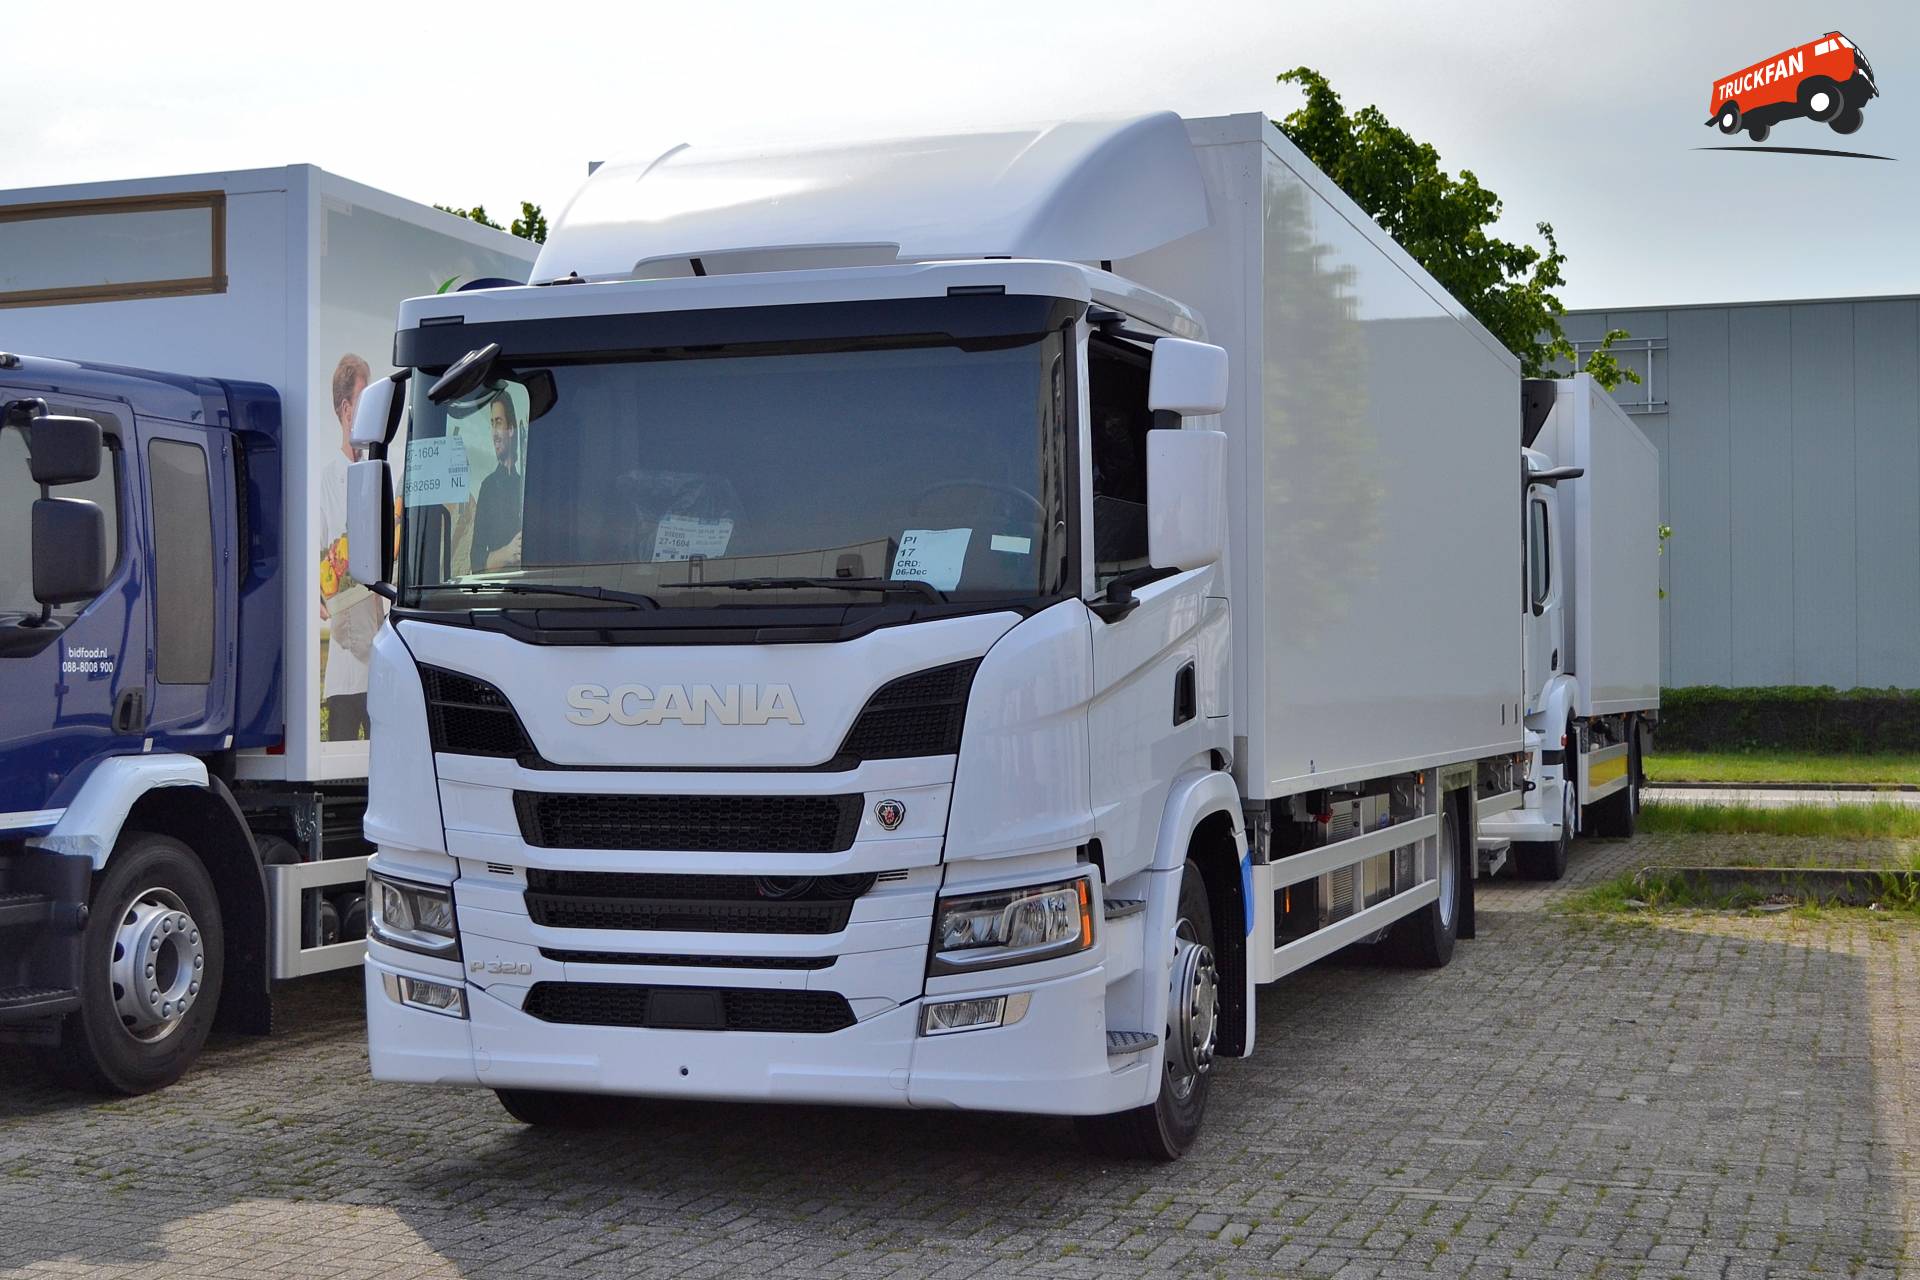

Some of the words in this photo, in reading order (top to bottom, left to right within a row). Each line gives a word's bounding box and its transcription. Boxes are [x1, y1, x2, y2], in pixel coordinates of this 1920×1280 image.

[451, 477, 465, 488] NL
[903, 536, 918, 545] PI
[900, 549, 916, 557] 17
[68, 647, 108, 658] bidfood.nl
[62, 661, 98, 673] 088-8008
[100, 661, 114, 673] 900
[565, 683, 805, 727] SCANIA
